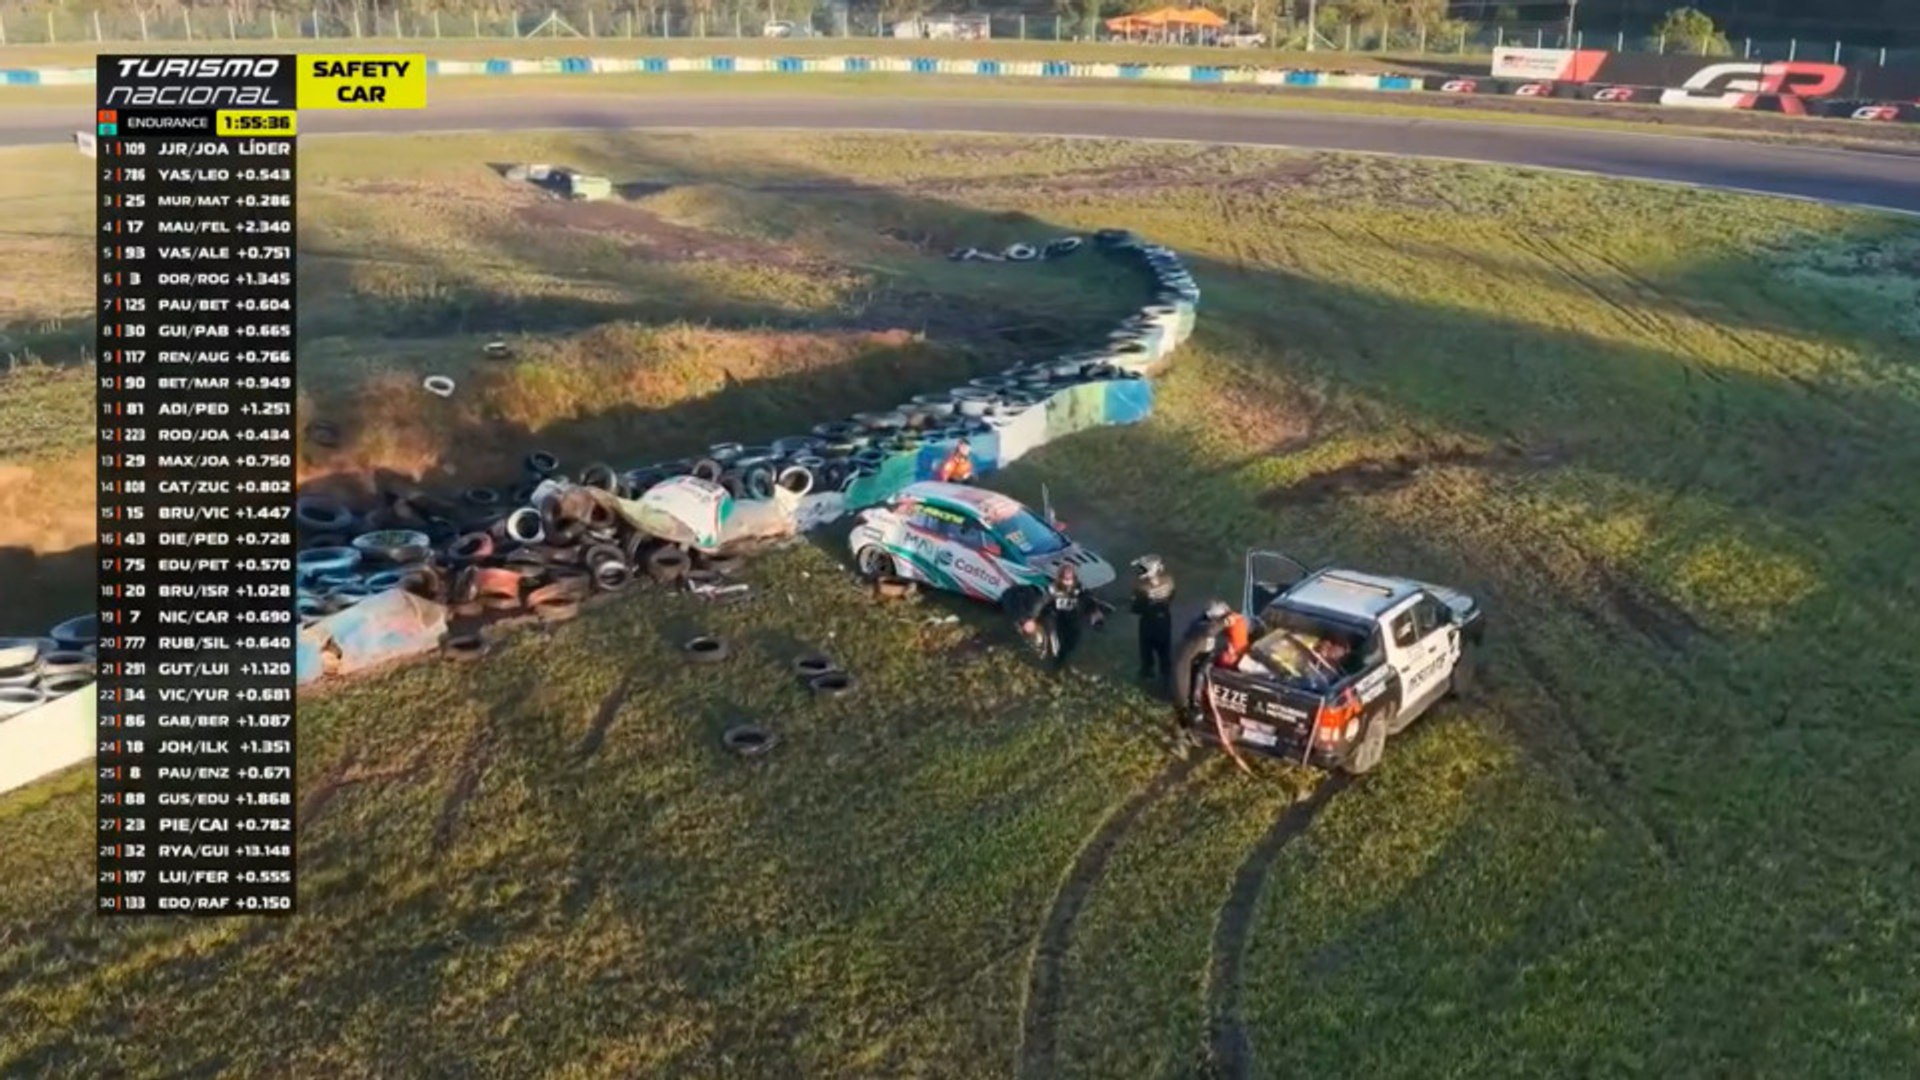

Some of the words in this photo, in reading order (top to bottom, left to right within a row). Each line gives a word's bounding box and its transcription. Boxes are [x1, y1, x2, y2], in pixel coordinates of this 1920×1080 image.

[1593, 87, 1633, 101] GR
[1660, 61, 1847, 116] GR
[1851, 106, 1899, 120] GR
[954, 558, 1000, 587] Castrol
